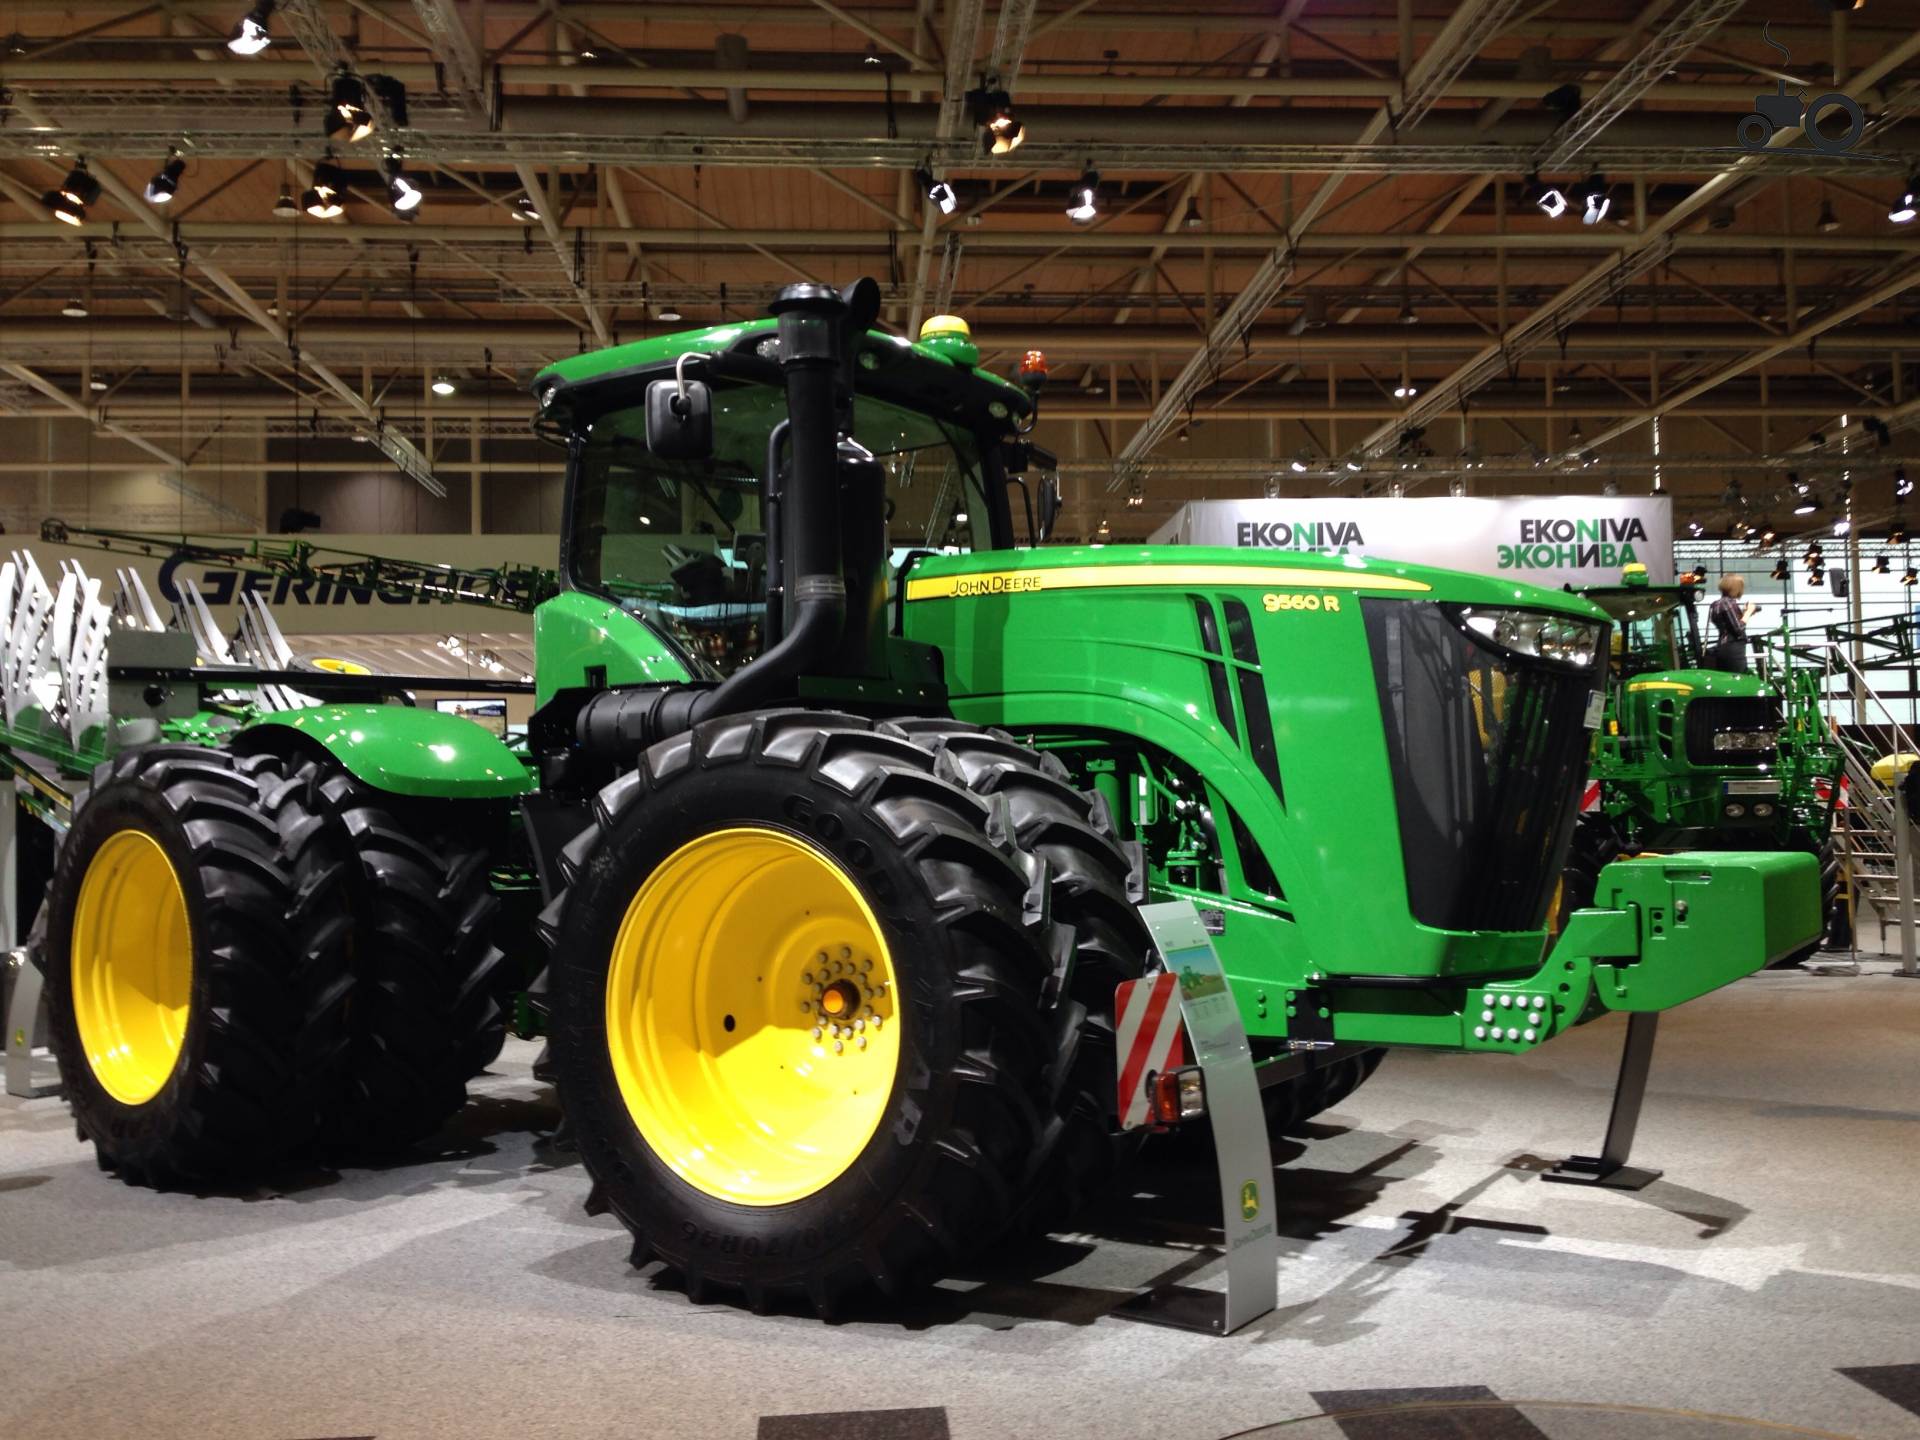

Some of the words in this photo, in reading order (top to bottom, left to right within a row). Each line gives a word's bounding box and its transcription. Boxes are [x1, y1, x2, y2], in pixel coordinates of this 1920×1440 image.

[1236, 521, 1365, 547] EKONIVA
[1521, 518, 1649, 543] EKONIVA
[1497, 543, 1639, 569] ЭКОНИВА
[950, 578, 990, 595] JOHN
[992, 575, 1041, 591] DEERE
[1262, 593, 1320, 612] 9560
[1322, 595, 1341, 612] R
